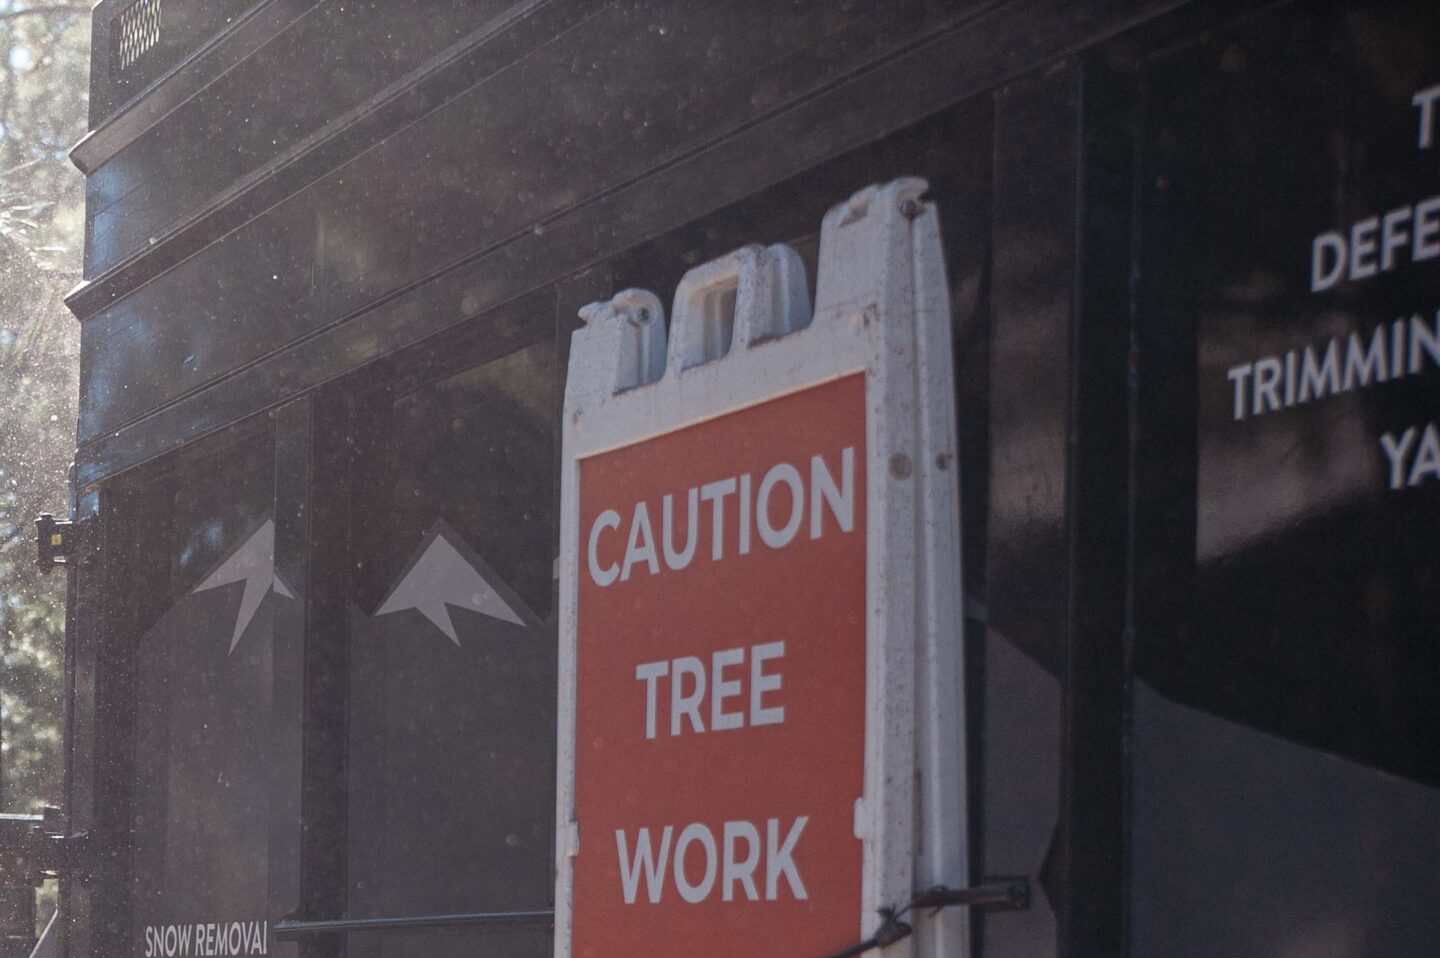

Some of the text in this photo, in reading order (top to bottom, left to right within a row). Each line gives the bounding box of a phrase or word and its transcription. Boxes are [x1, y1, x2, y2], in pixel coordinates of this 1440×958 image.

[1310, 194, 1440, 293] DEFE
[587, 446, 855, 587] CAUTION
[635, 639, 785, 740] TREE
[615, 815, 809, 905] WORK
[145, 924, 192, 957] SNOW
